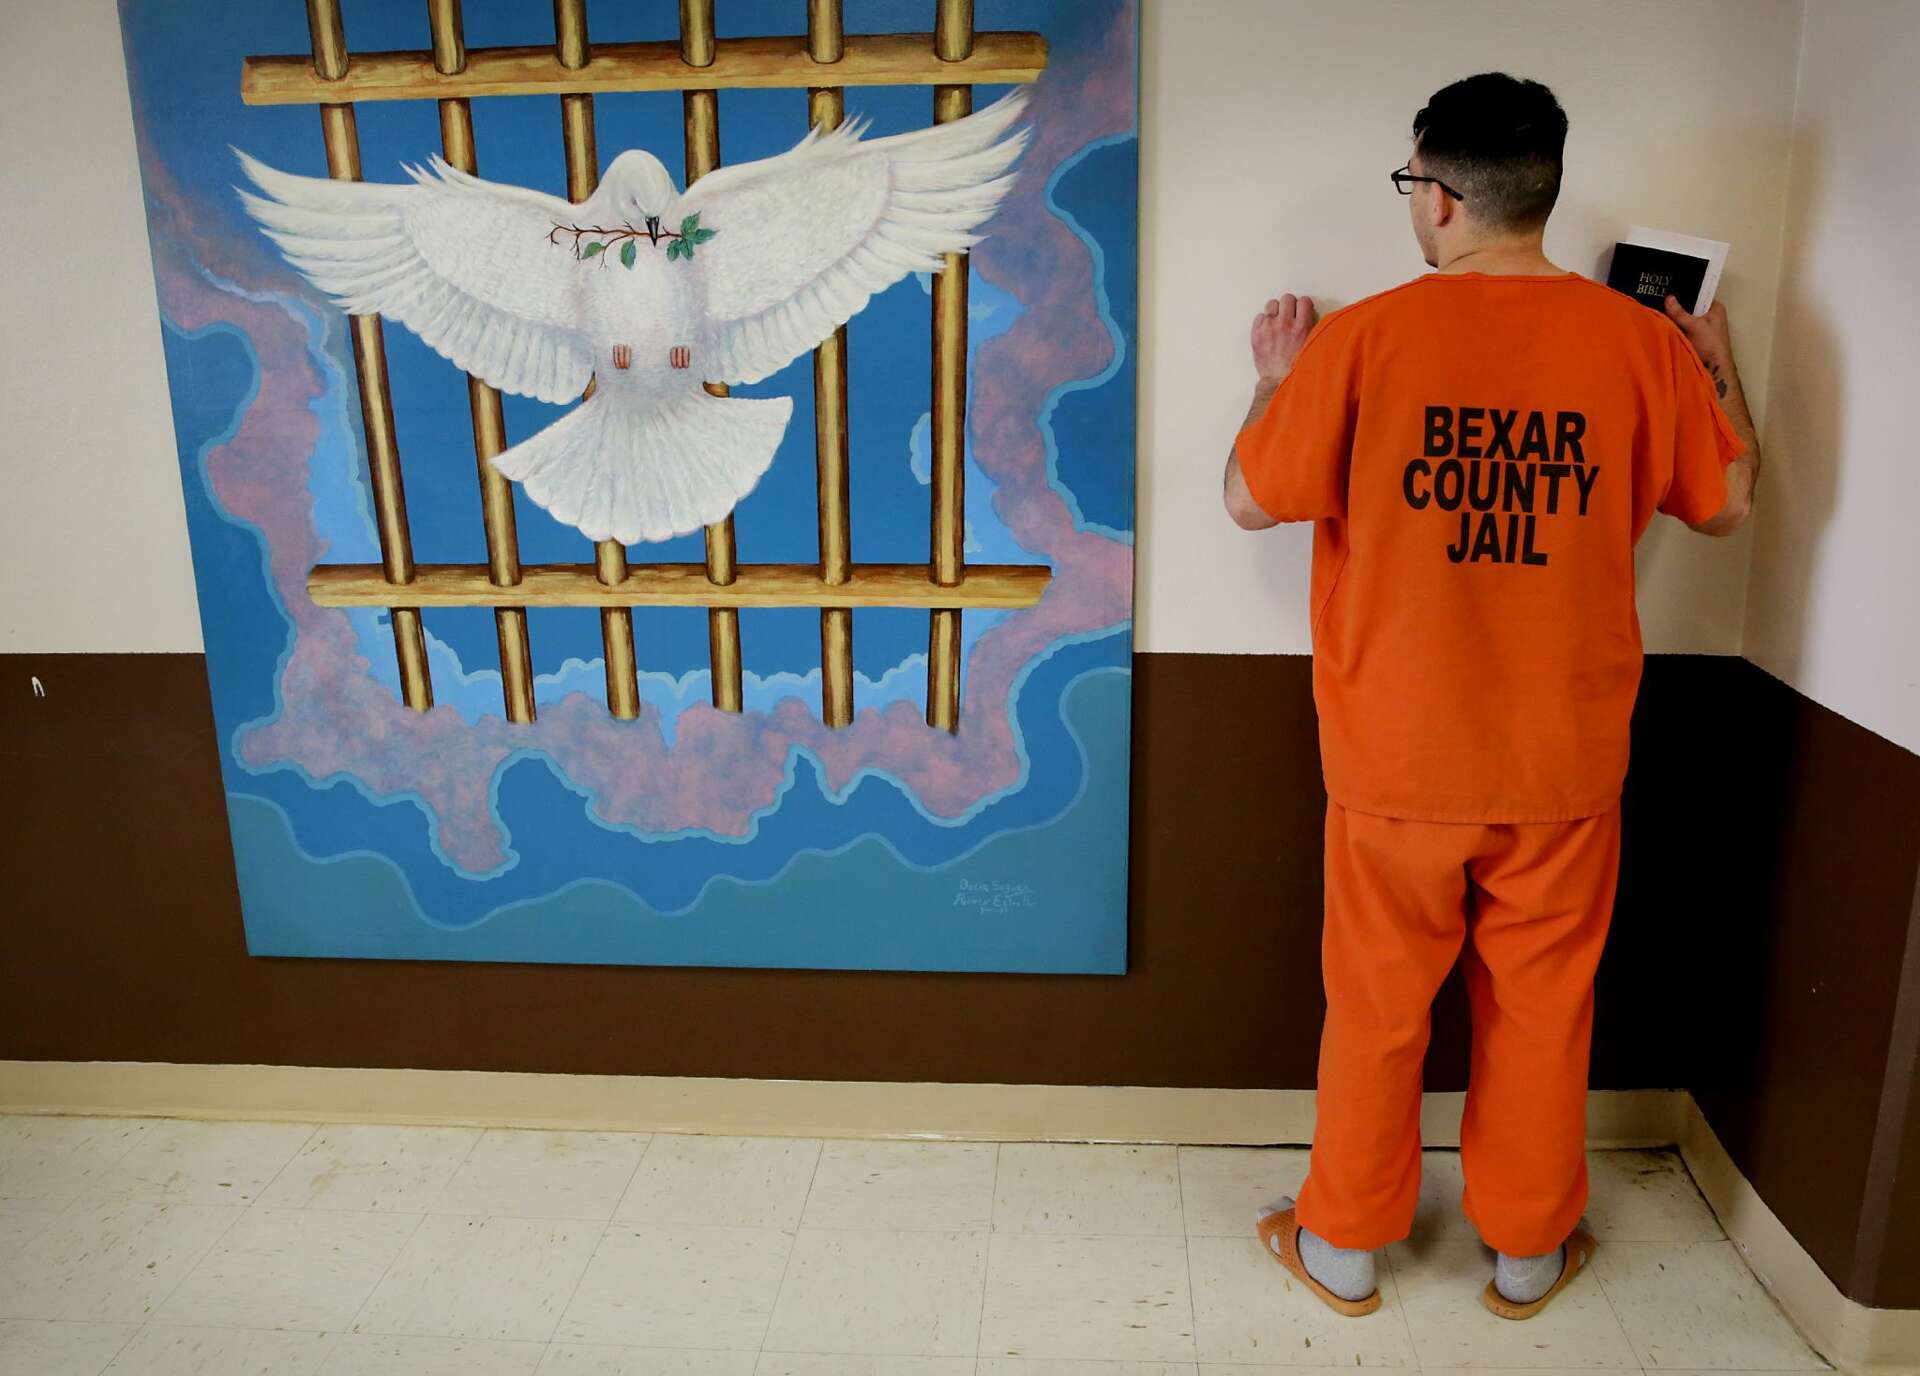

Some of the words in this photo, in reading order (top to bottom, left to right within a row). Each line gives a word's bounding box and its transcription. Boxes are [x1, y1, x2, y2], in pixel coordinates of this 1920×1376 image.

[1636, 283, 1667, 297] BIBLE
[1639, 271, 1673, 286] HOLY
[1423, 405, 1587, 464] BEXAR
[1403, 458, 1600, 516] COUNTY
[1446, 511, 1549, 567] JAIL
